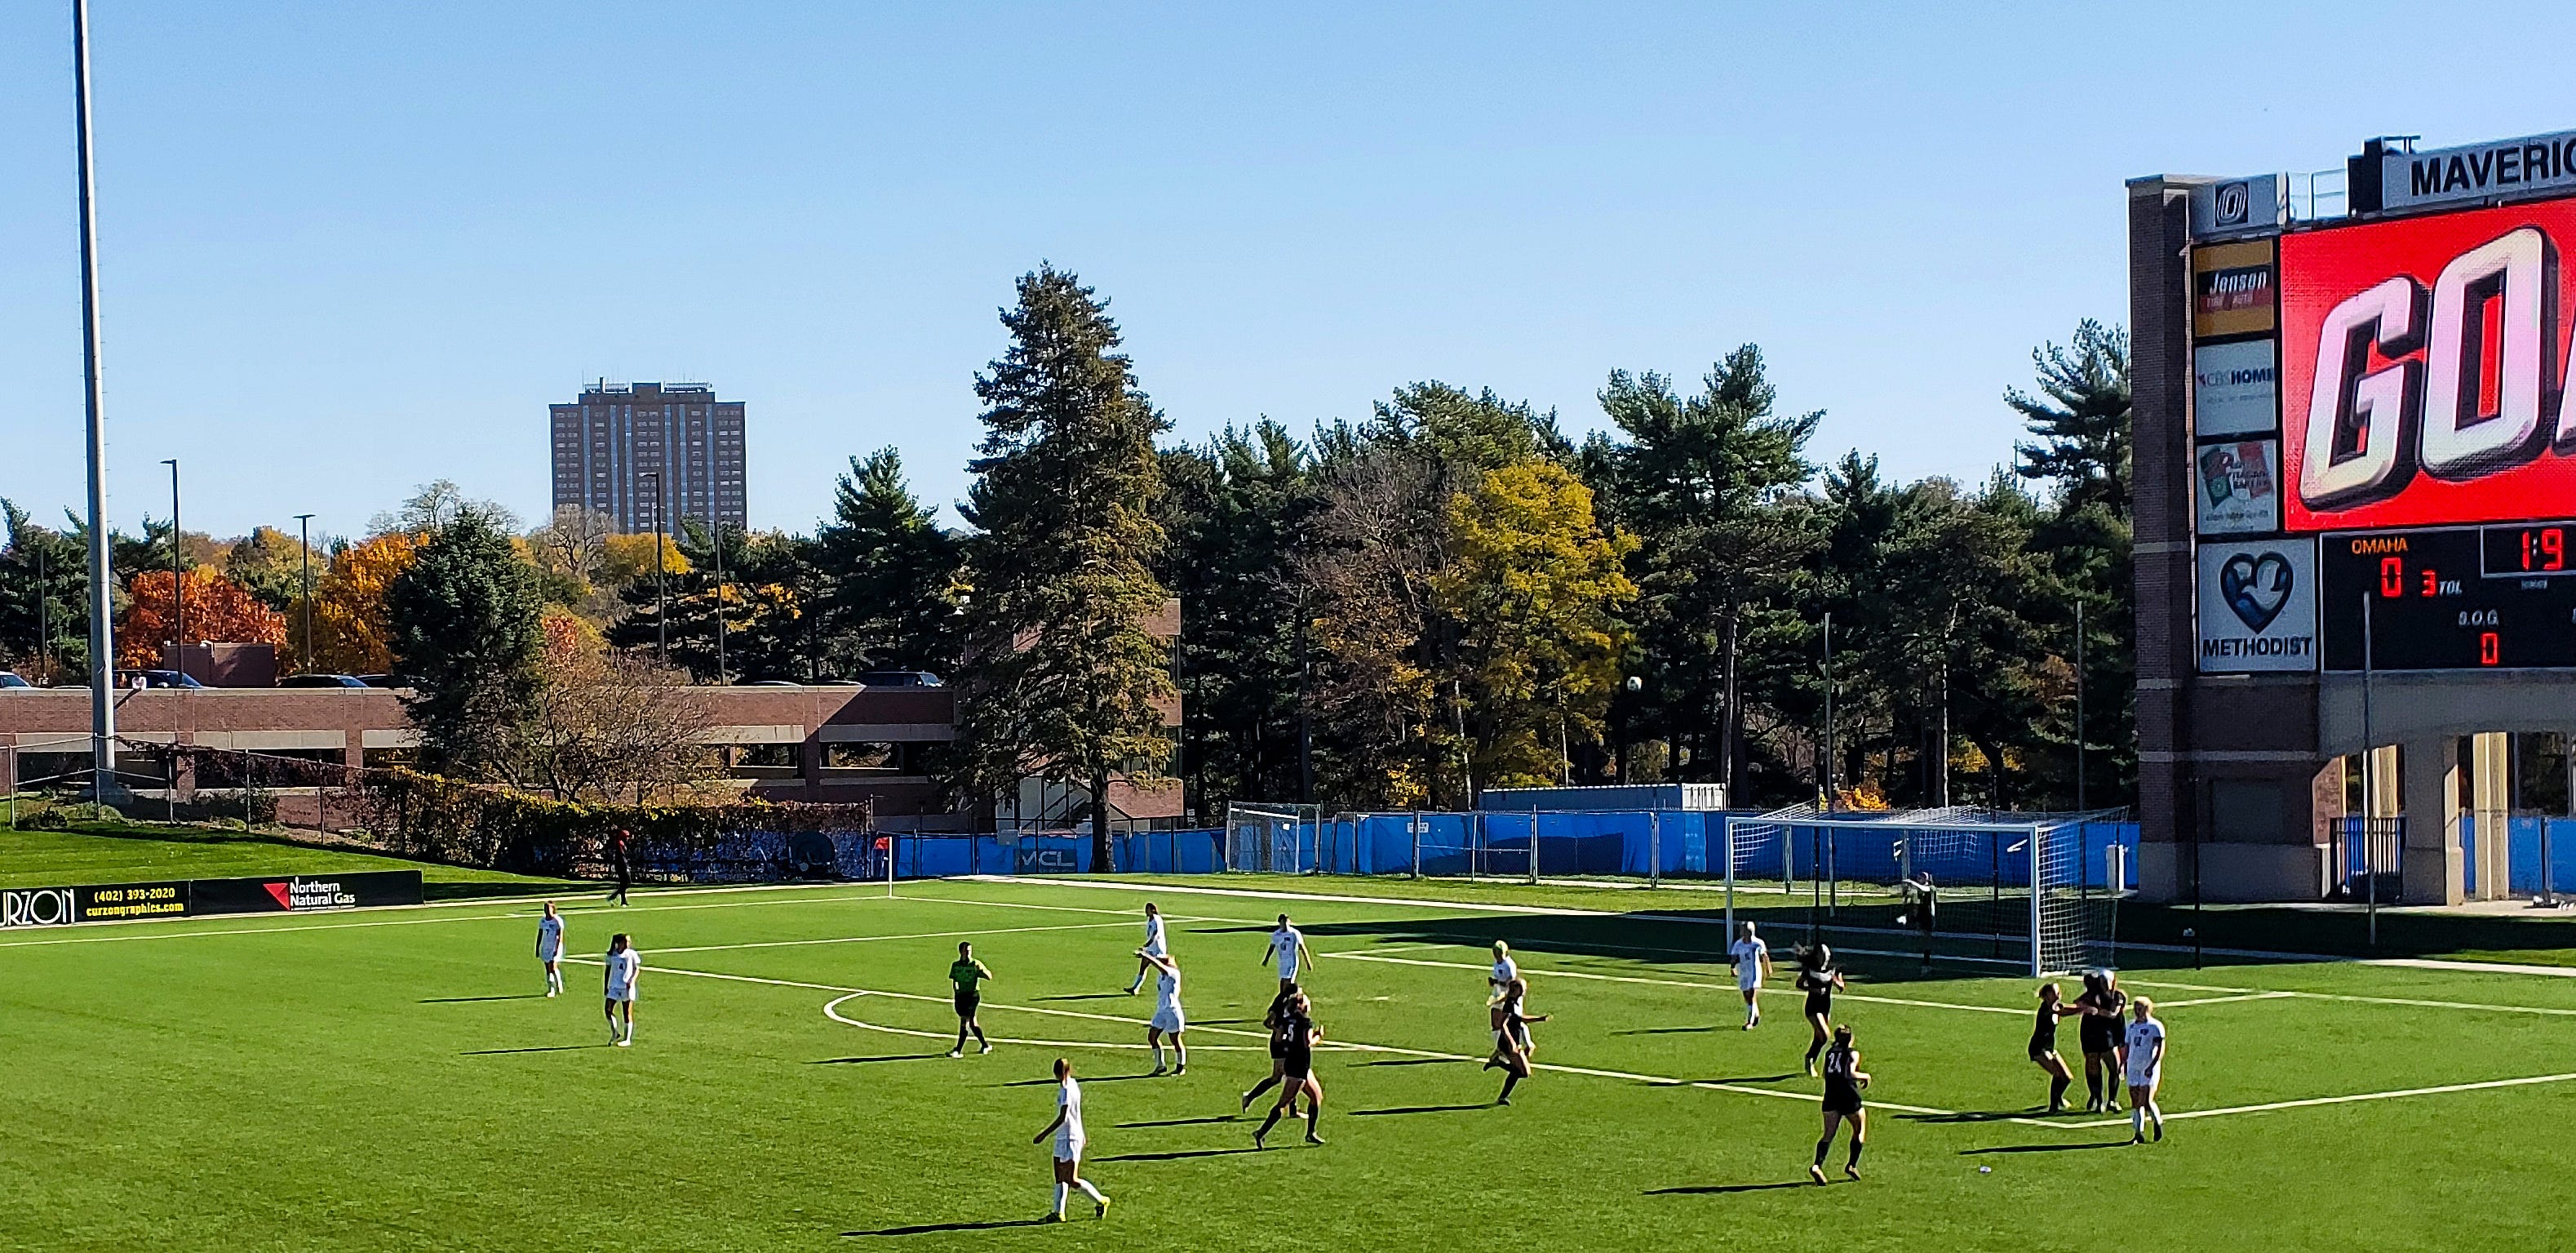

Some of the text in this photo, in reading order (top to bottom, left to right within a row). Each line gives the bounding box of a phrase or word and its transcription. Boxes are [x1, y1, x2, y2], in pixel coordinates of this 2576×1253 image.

[2299, 224, 2576, 512] GO
[2352, 537, 2408, 554] OMAHA
[2381, 557, 2401, 598] 0
[2421, 570, 2436, 597] 3
[2202, 637, 2312, 657] METHODIST
[2481, 633, 2498, 664] 0
[290, 876, 340, 894] Northern
[94, 887, 175, 903] (402) 393-2020
[290, 892, 356, 907] Natural Gas
[86, 902, 184, 917] curzongraphics.com
